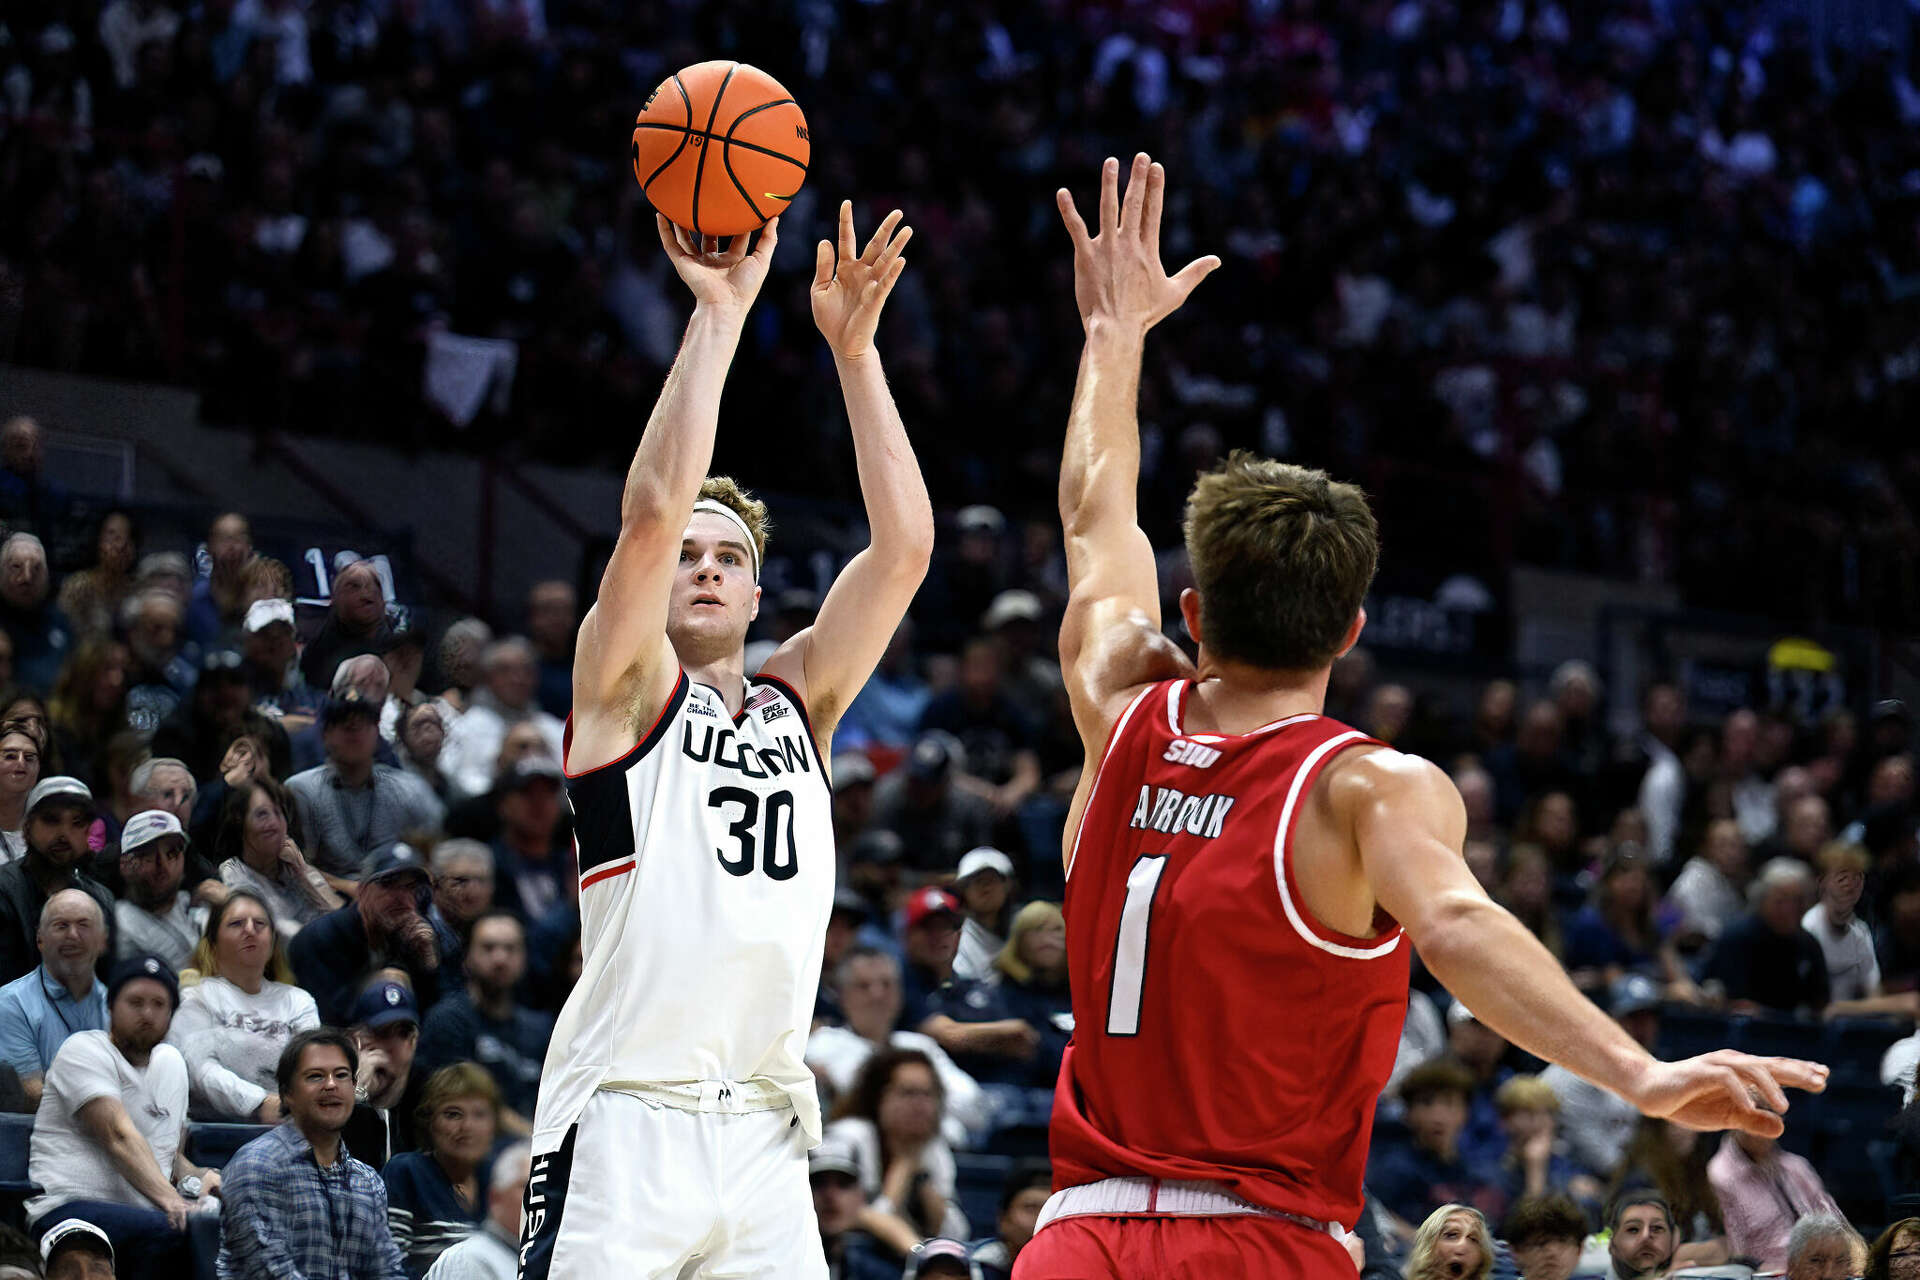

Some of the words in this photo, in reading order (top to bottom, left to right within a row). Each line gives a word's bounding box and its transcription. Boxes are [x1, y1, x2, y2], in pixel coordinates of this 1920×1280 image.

[761, 702, 781, 716] BIG
[763, 707, 789, 721] EAST
[708, 786, 799, 881] 30
[1106, 854, 1171, 1037] 1
